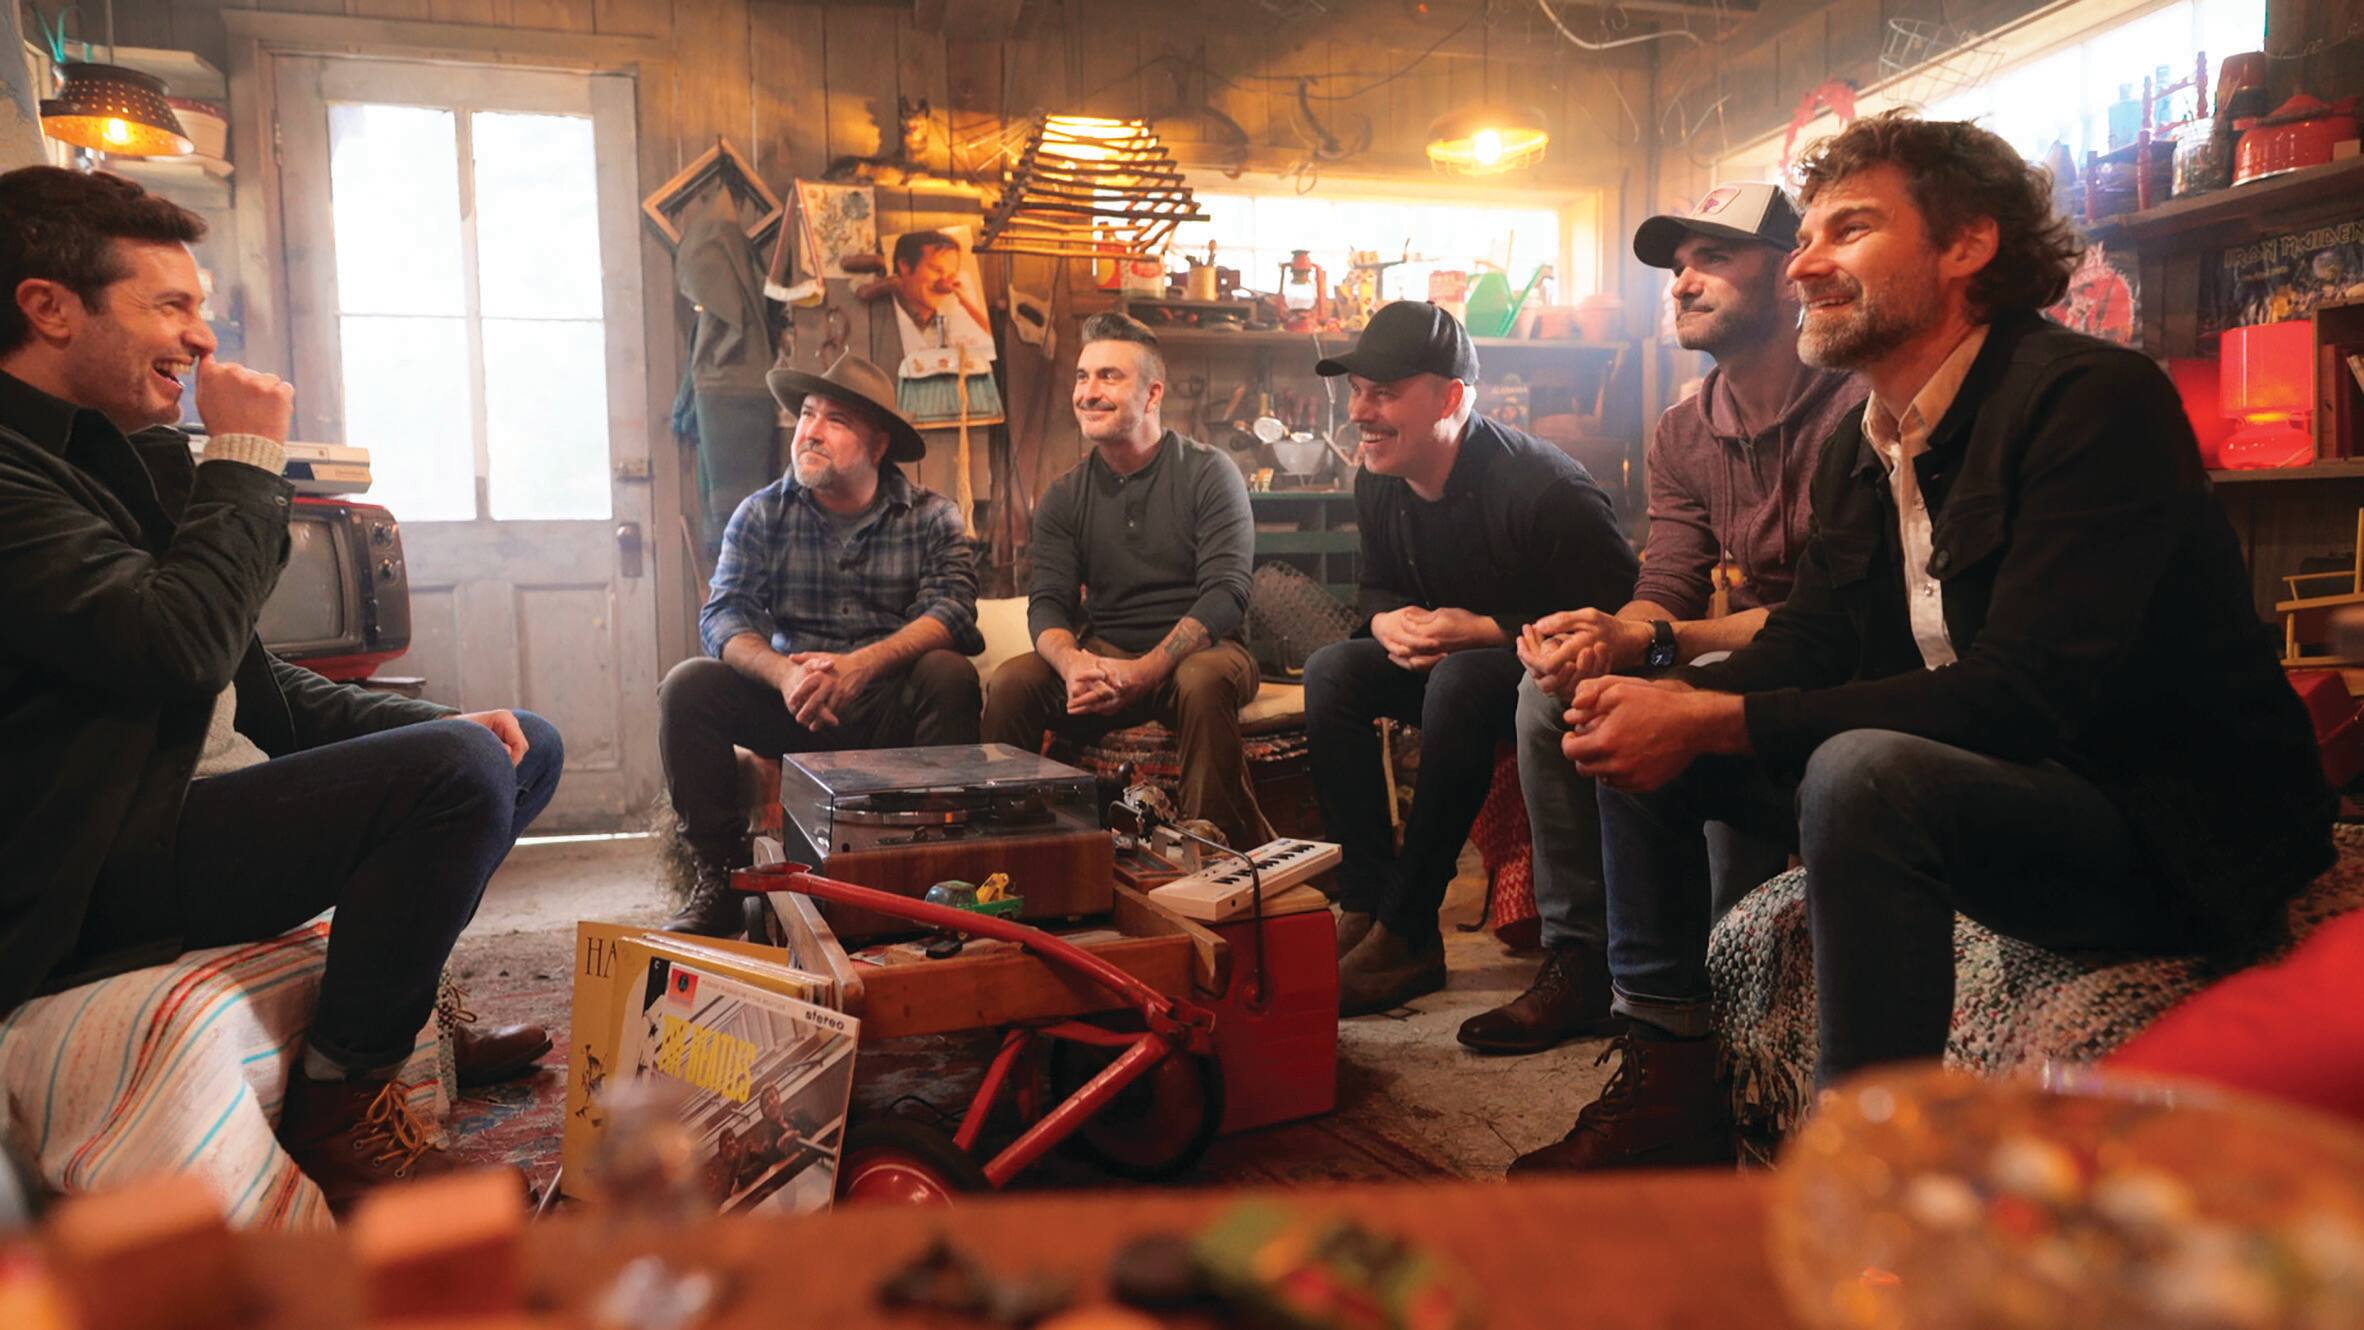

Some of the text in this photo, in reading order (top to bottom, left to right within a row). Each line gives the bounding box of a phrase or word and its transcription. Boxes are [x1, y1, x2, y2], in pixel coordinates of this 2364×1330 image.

[2224, 240, 2277, 269] IRON
[805, 1010, 845, 1031] stereo
[658, 1014, 758, 1104] THE BEATLES
